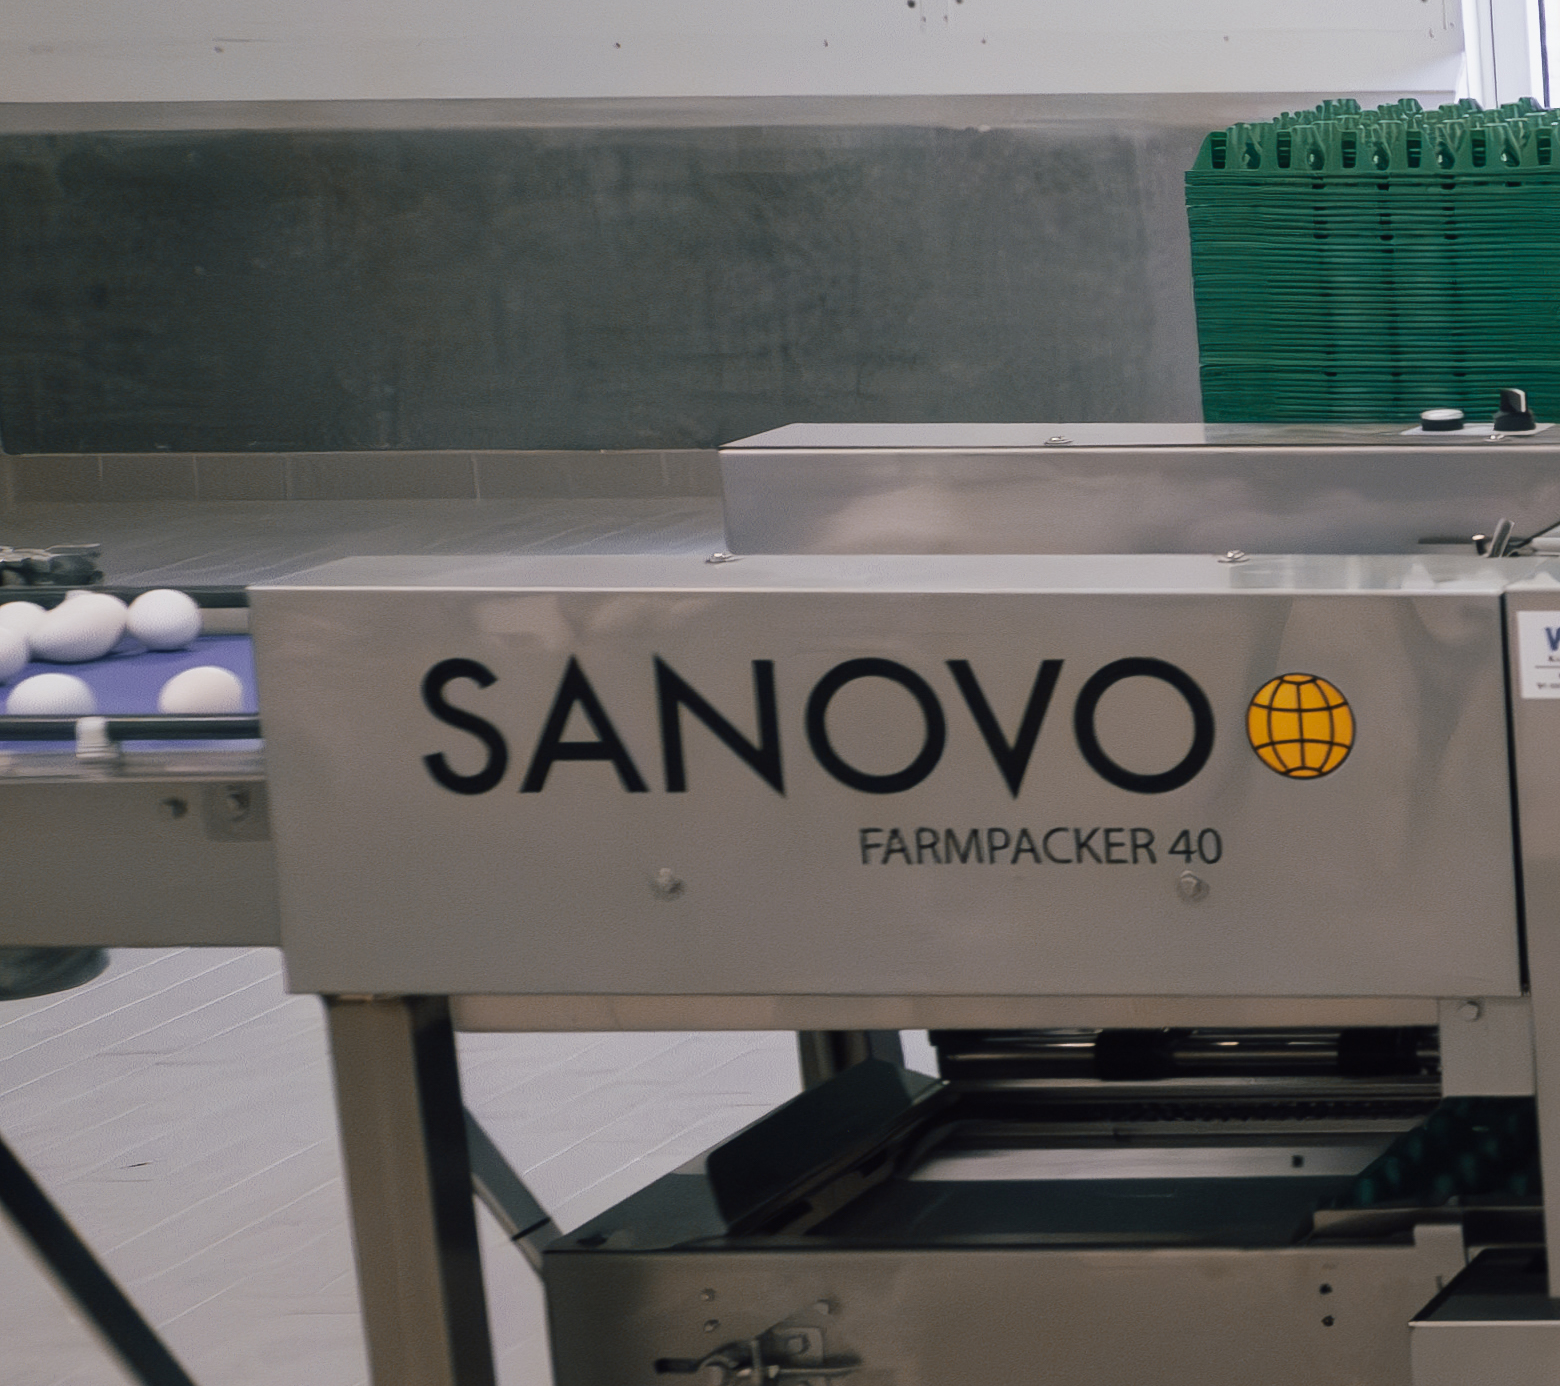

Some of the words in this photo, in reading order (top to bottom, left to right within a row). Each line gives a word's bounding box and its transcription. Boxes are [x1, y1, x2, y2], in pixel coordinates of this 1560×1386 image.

[420, 655, 1217, 799] SANOVO
[859, 825, 1158, 866] FARMPACKER
[1167, 826, 1224, 866] 40
